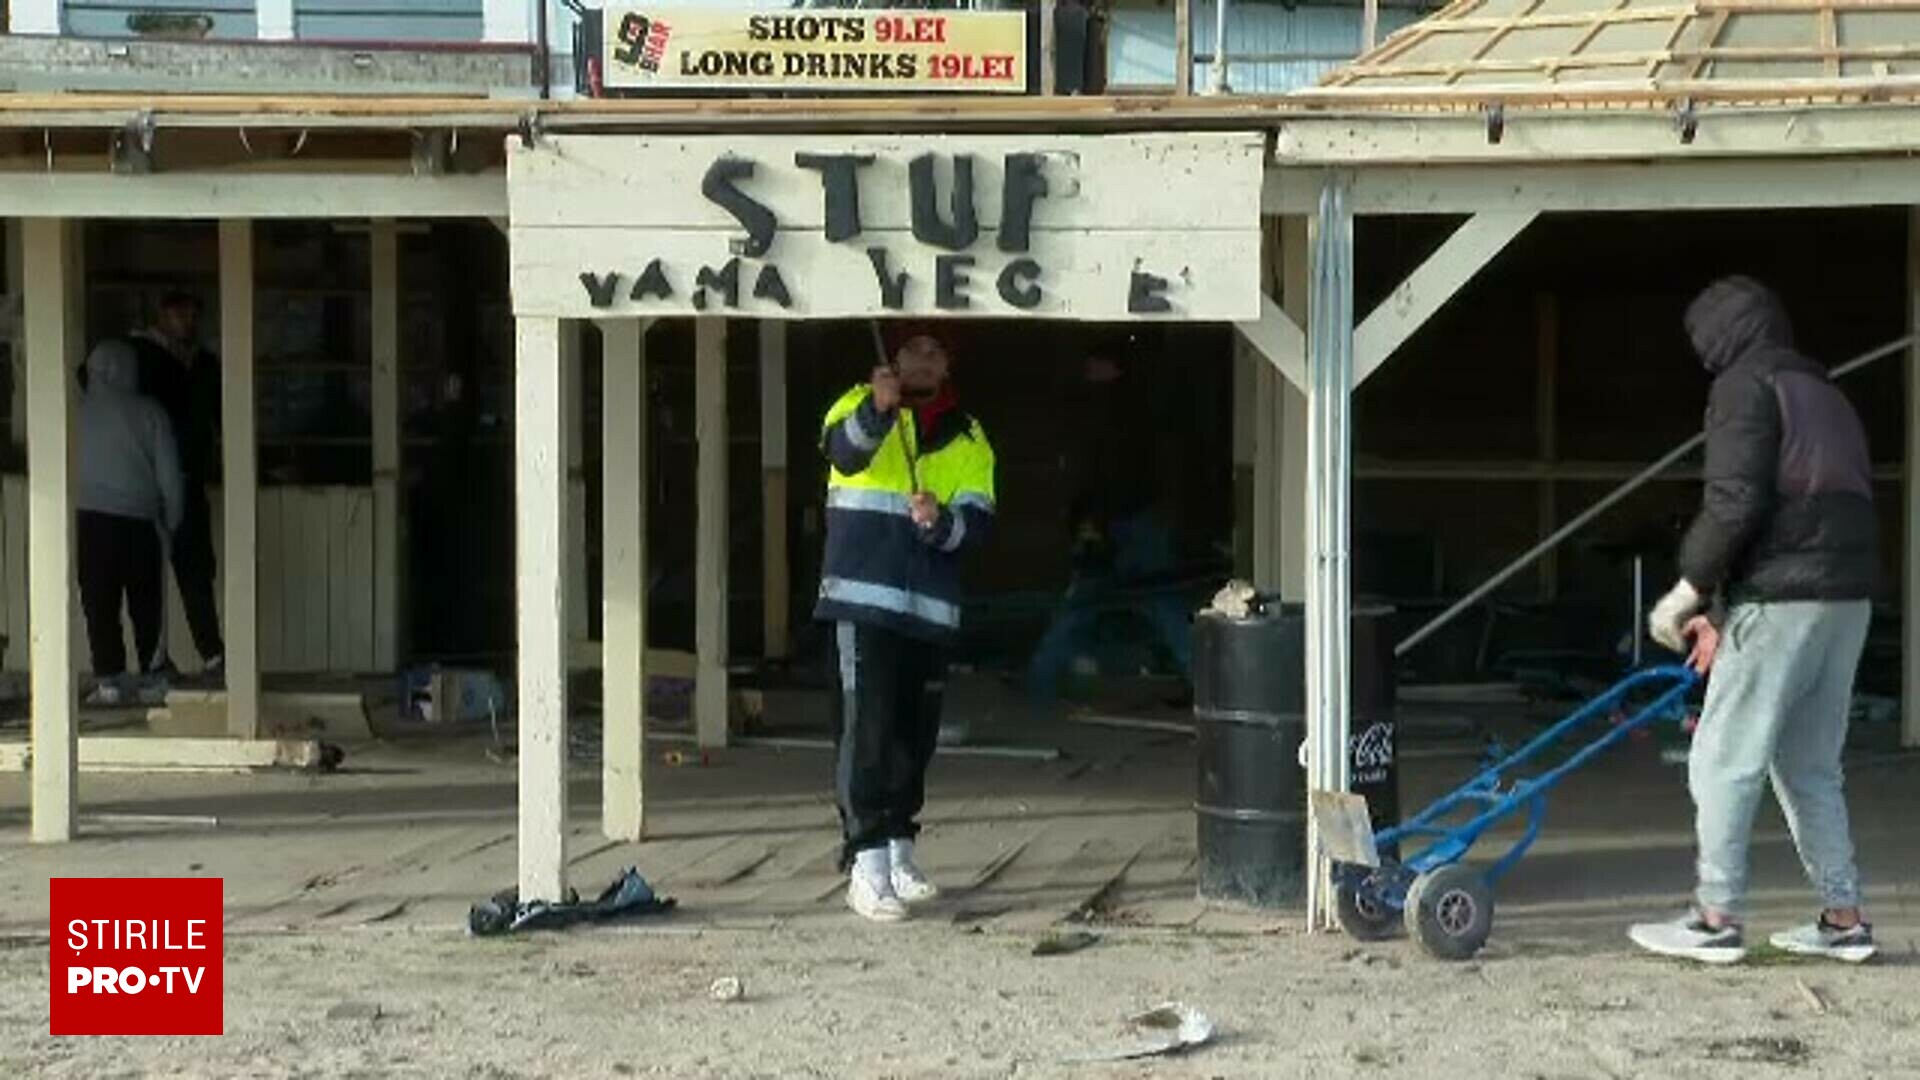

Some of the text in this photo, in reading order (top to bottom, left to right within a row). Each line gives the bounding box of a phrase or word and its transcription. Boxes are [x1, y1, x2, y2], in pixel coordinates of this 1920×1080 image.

[749, 15, 946, 43] SHOTS 9LEI
[680, 51, 1015, 79] LONG DRINKS 19LEI
[578, 257, 793, 310] VAMA
